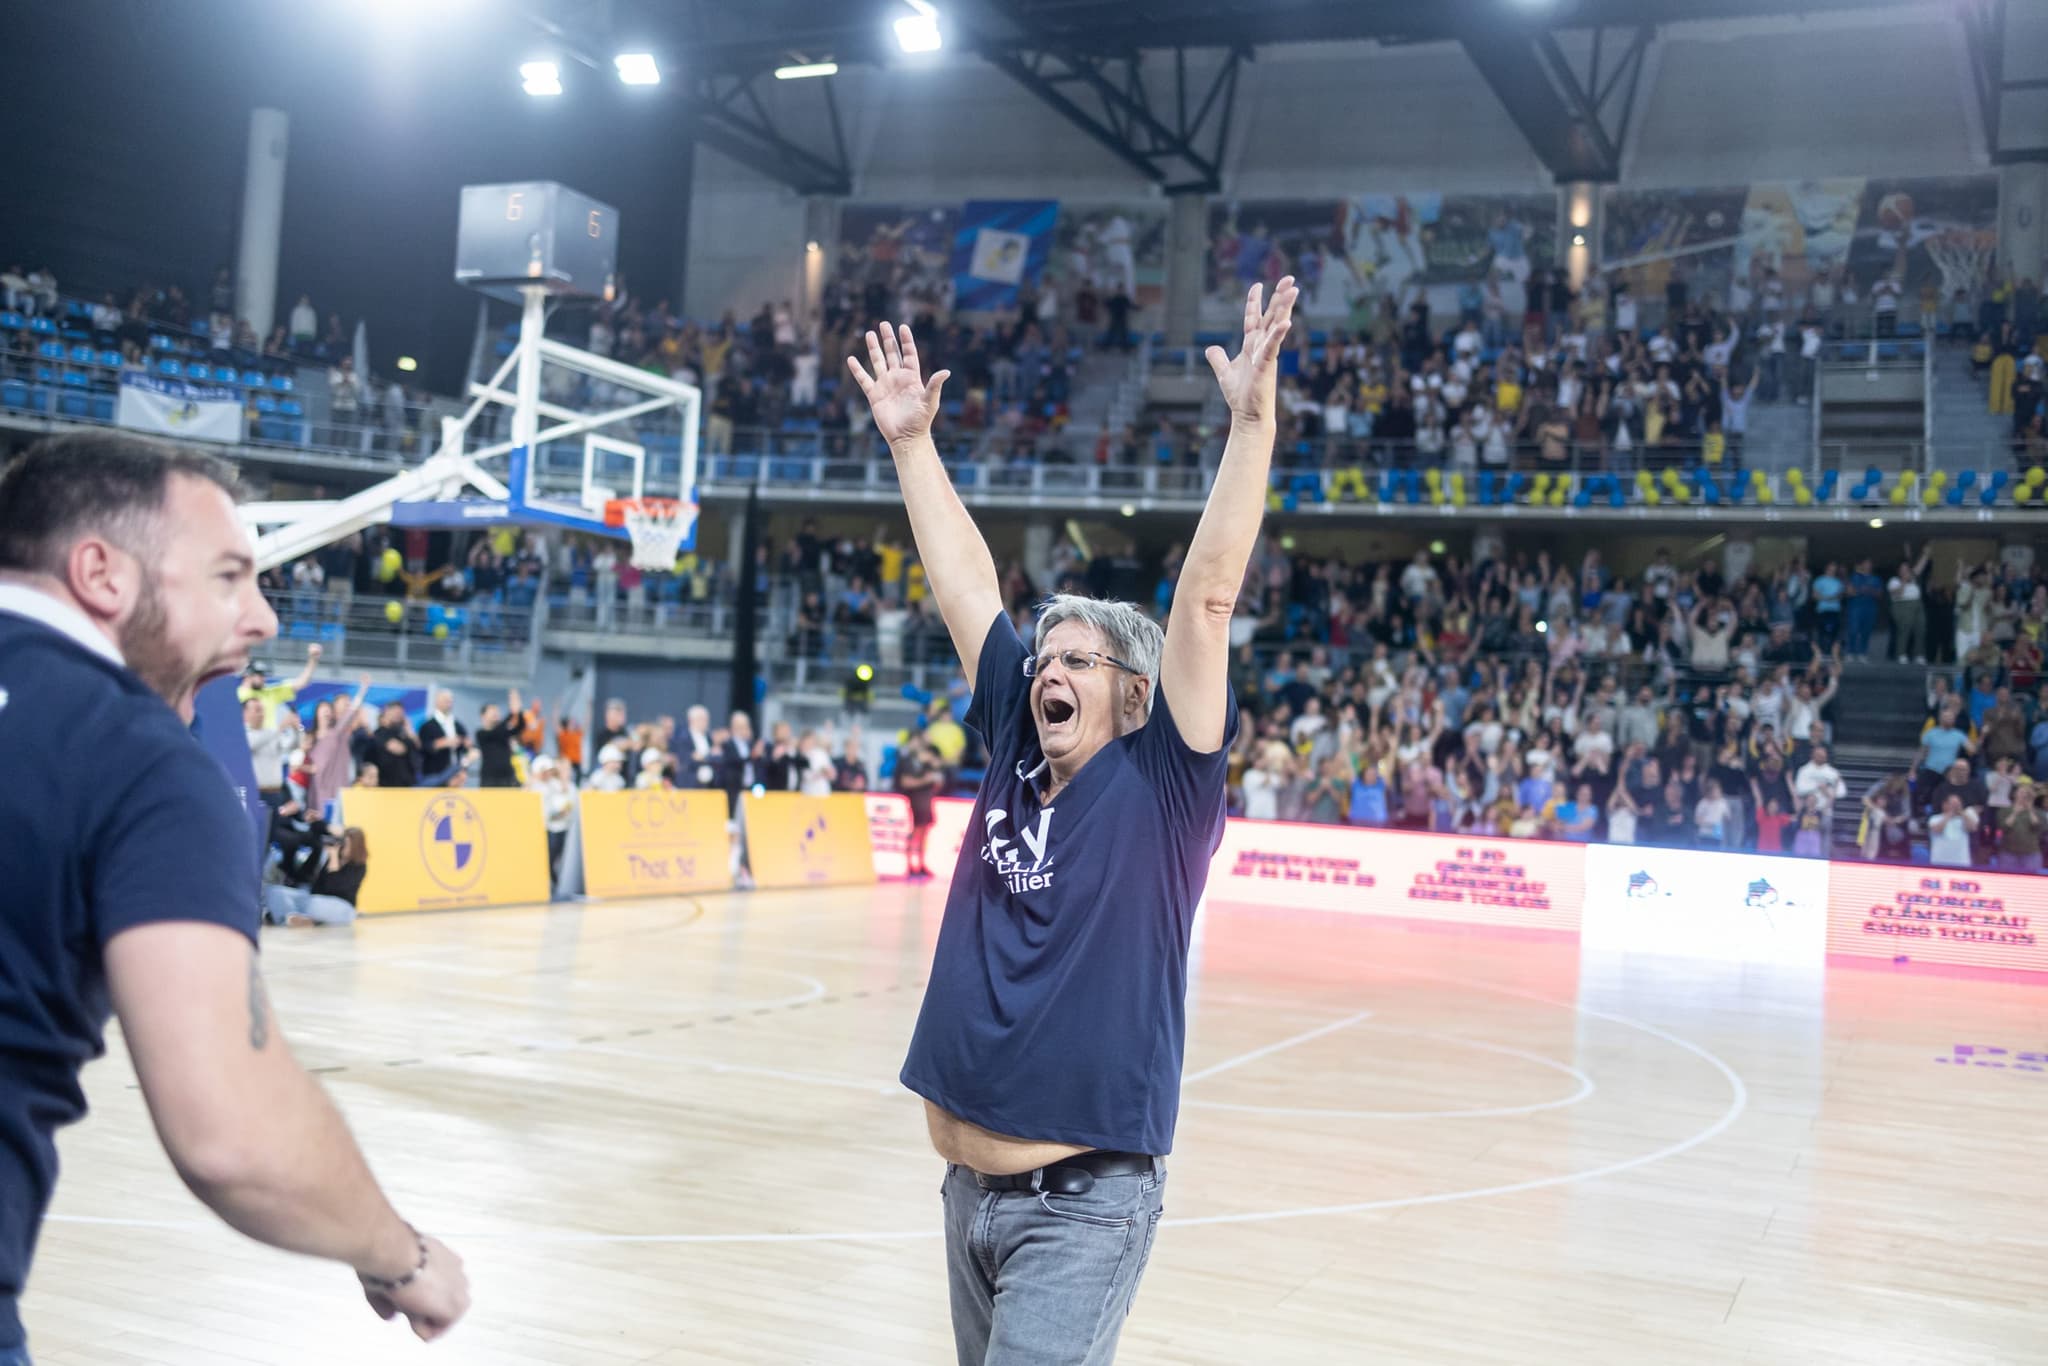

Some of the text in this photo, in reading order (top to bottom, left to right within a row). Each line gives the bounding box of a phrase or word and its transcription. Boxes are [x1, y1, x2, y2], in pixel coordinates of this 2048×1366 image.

[506, 192, 525, 221] 6
[587, 209, 602, 238] 6
[1004, 872, 1055, 894] ilier
